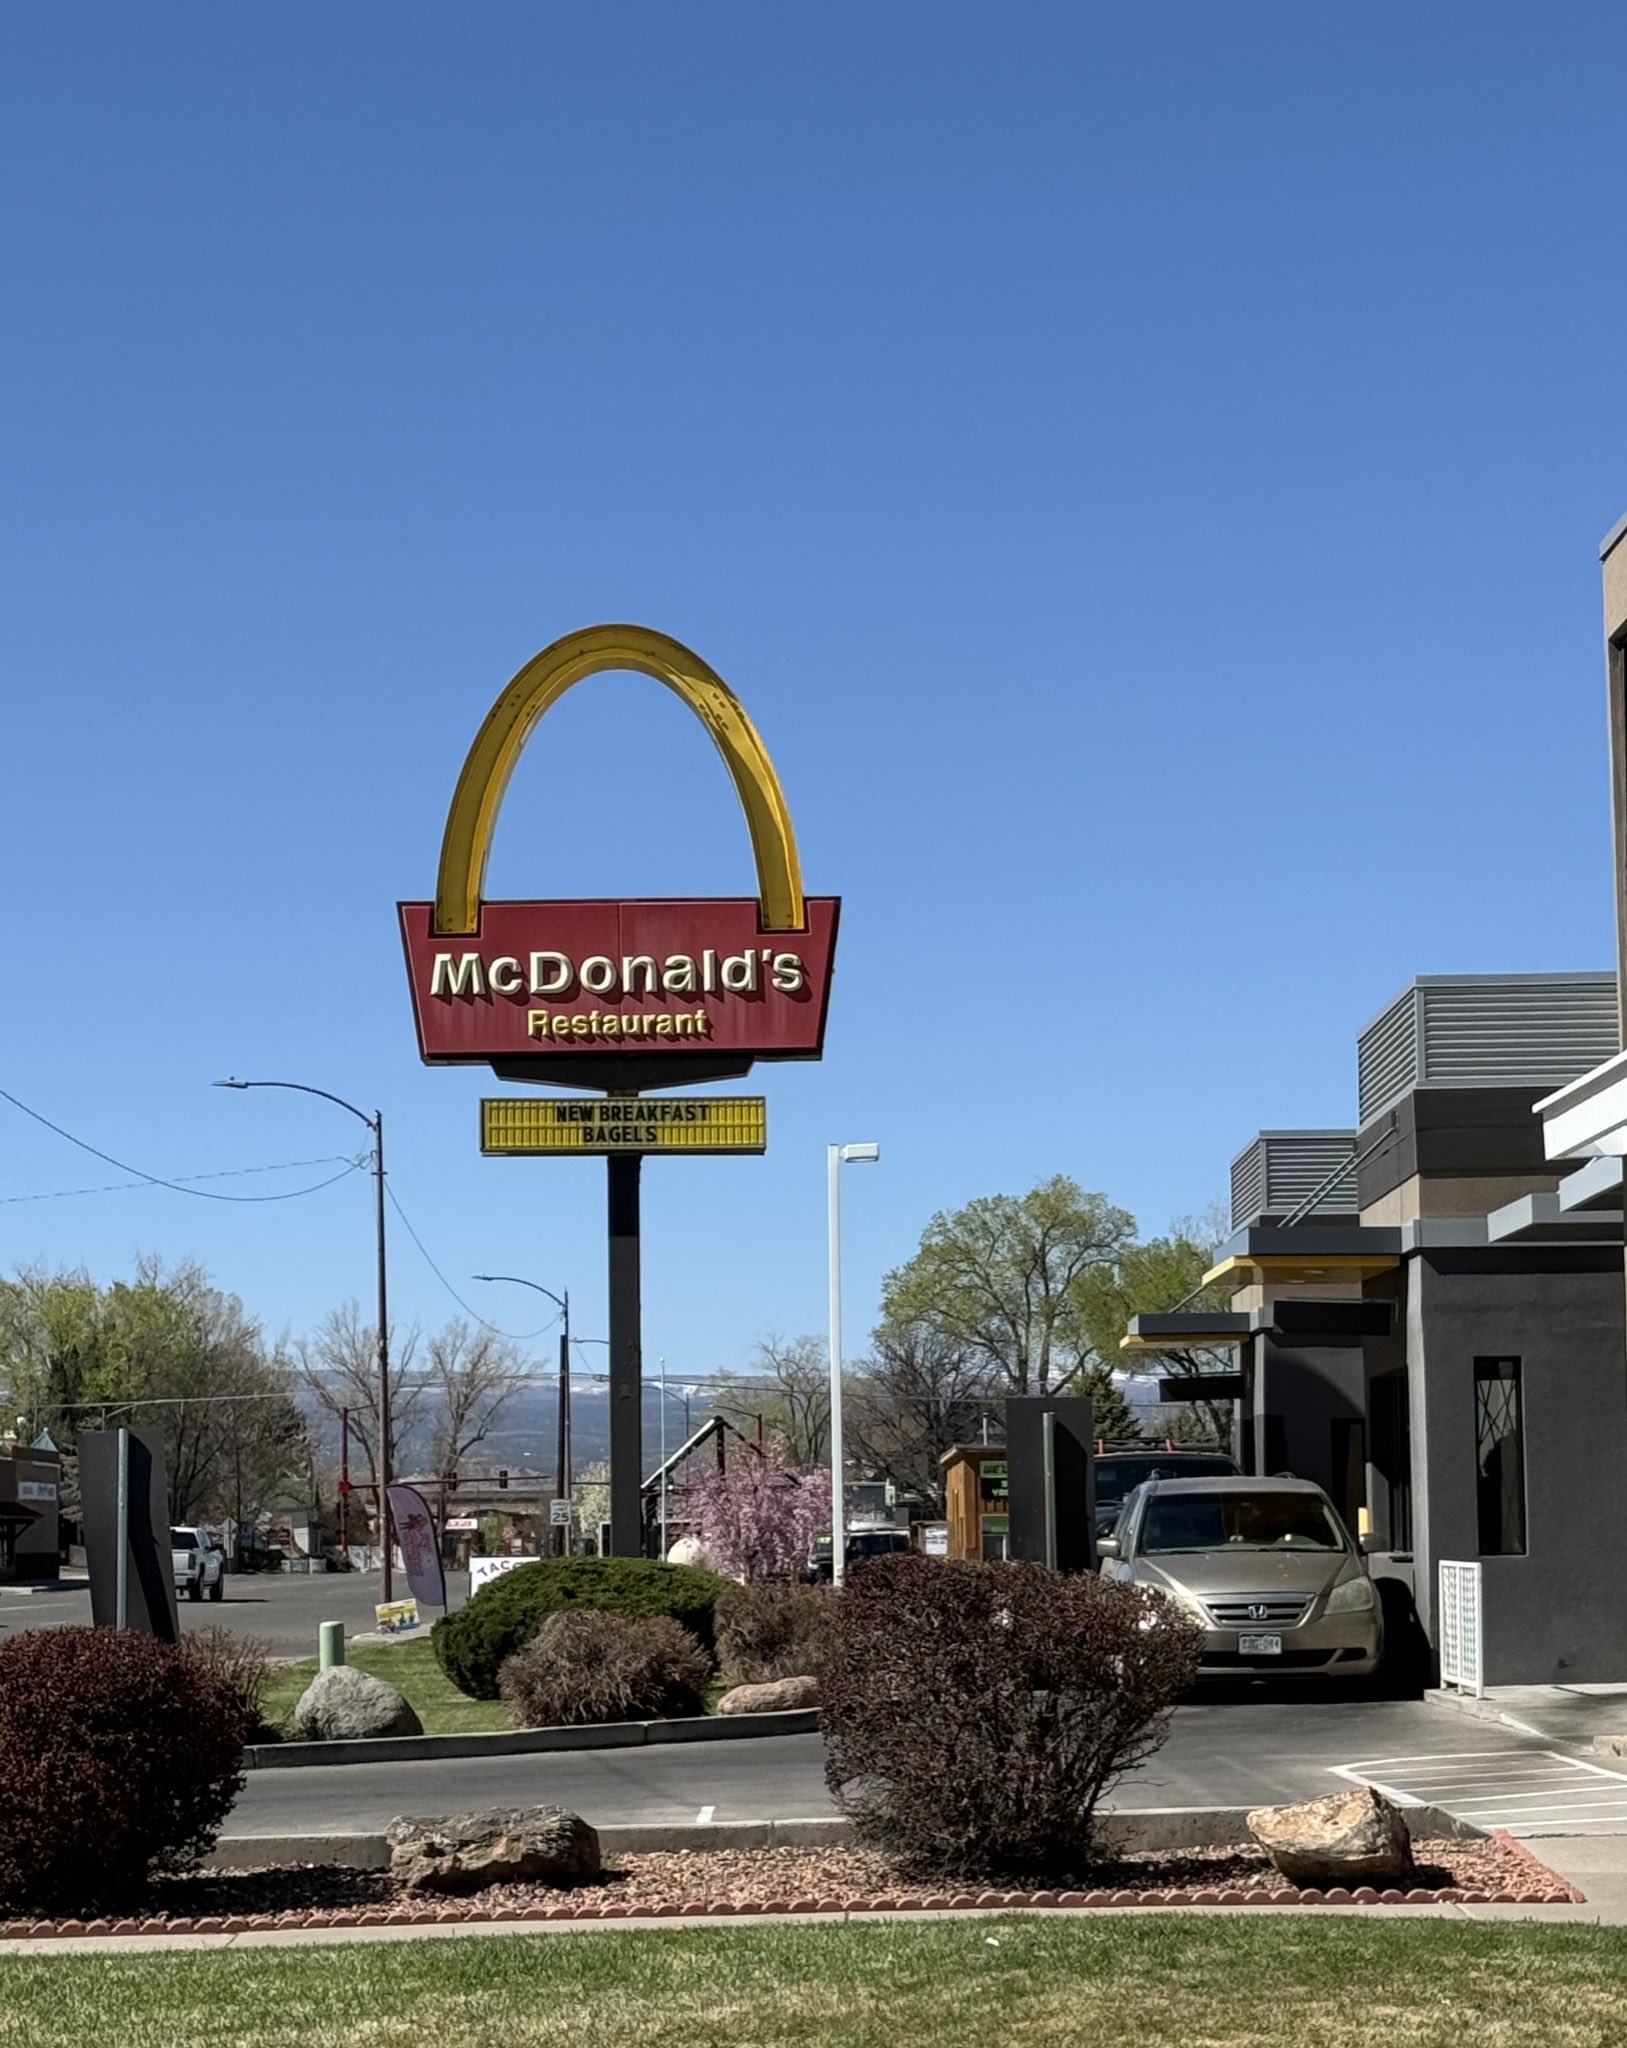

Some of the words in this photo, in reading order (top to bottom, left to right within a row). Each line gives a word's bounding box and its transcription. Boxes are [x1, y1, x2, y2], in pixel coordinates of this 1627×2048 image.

[430, 949, 804, 996] McDonald's
[527, 1009, 709, 1037] Restaurant
[556, 1105, 594, 1122] NEW
[600, 1104, 710, 1122] BREAKFAST
[582, 1125, 658, 1143] BAGELS
[552, 1512, 569, 1523] 25
